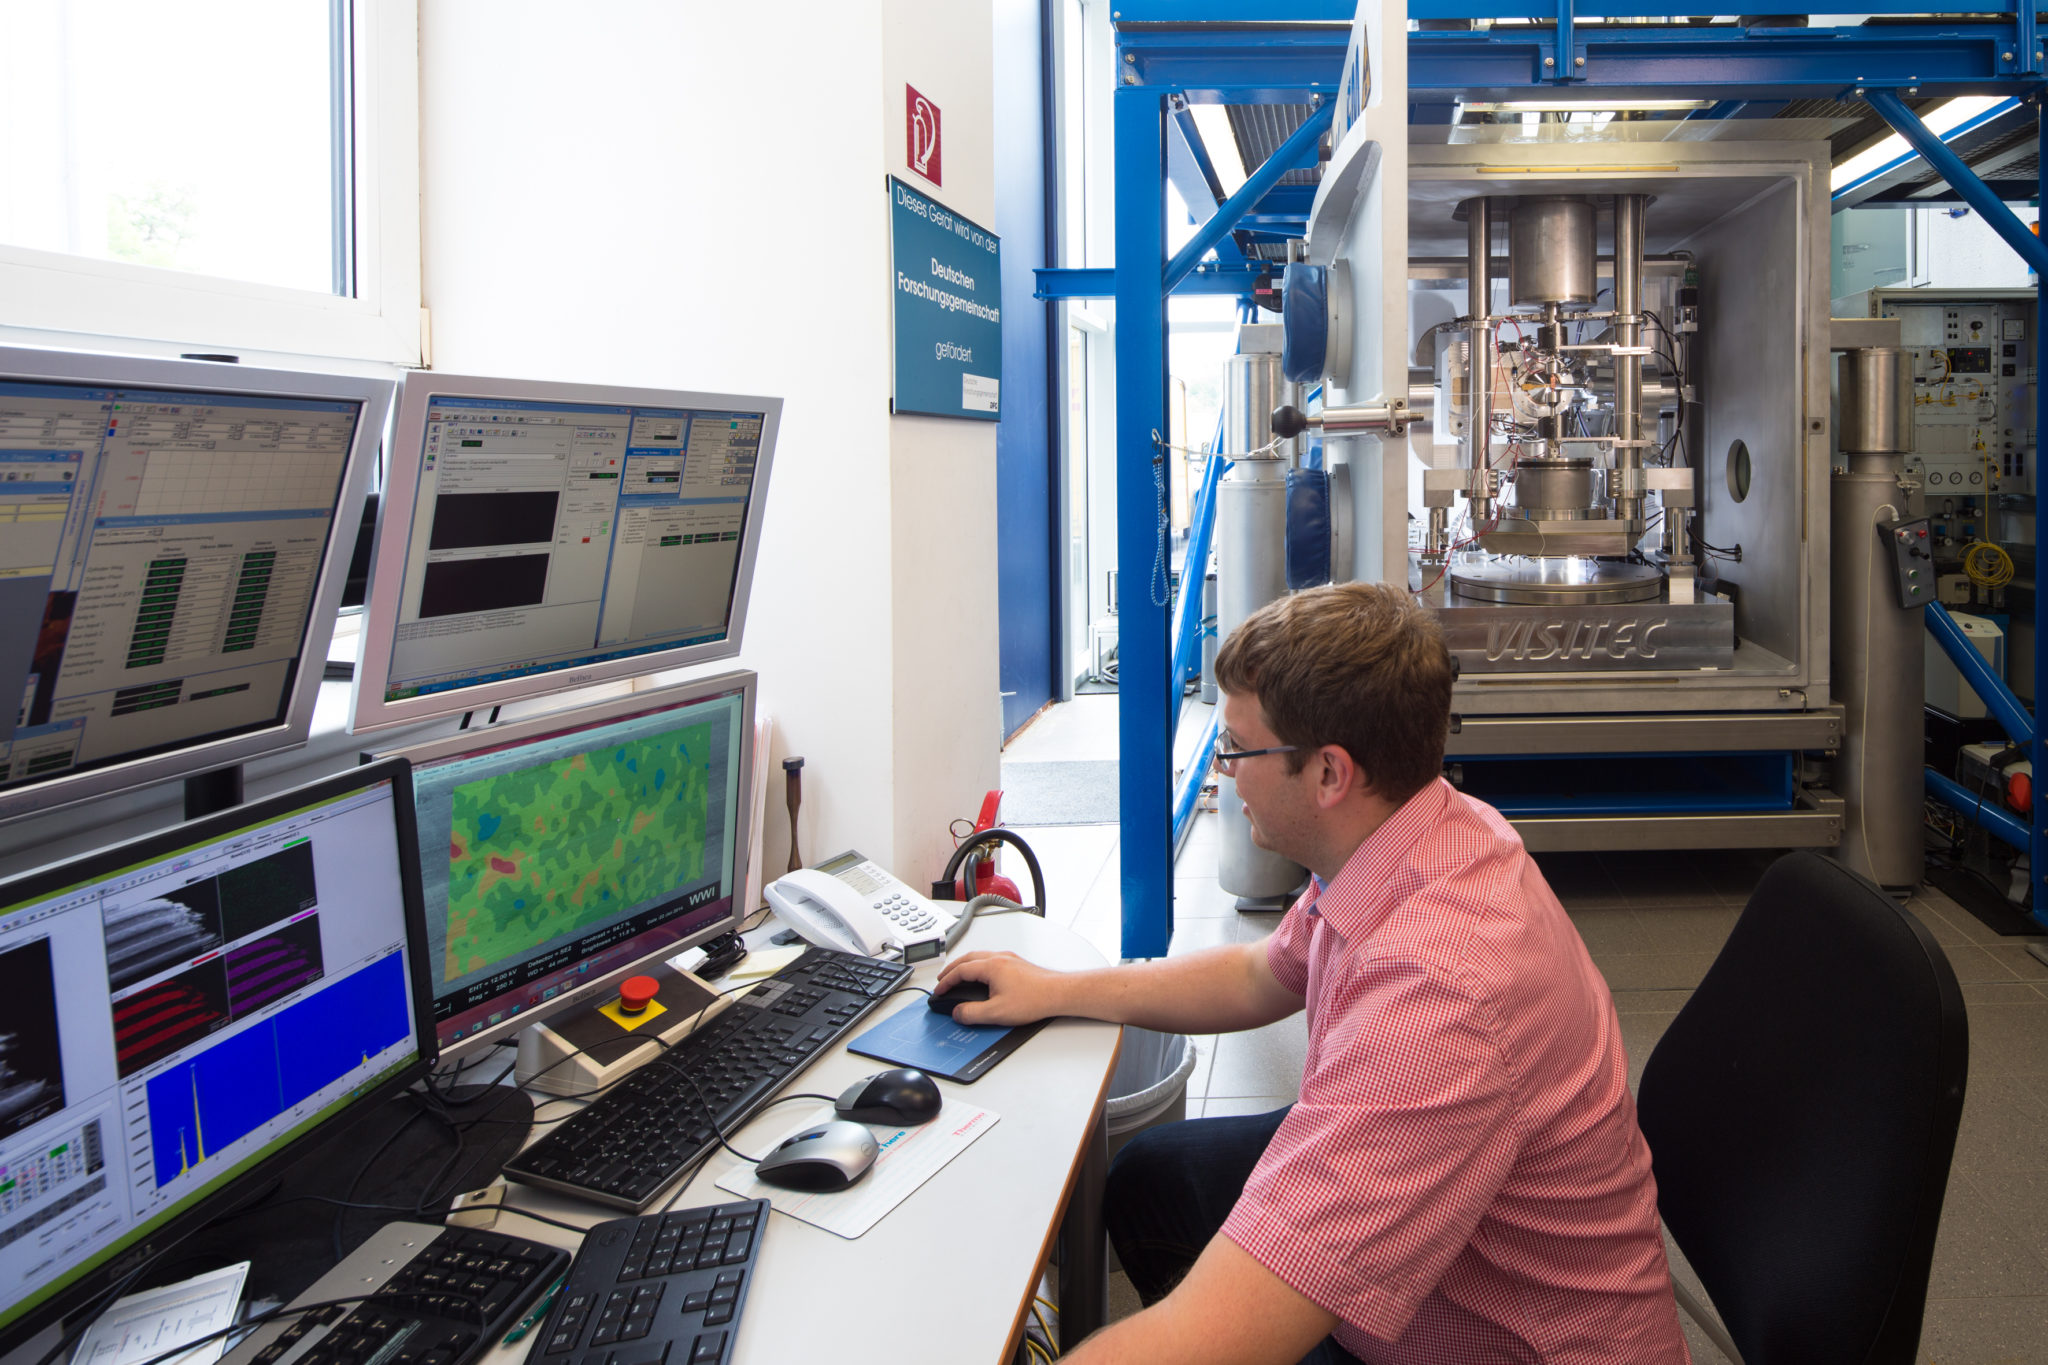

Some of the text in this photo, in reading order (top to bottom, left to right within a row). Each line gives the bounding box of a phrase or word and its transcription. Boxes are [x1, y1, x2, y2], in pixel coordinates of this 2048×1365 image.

[897, 185, 997, 254] Dieses Gerät wird von der
[931, 257, 974, 291] Deutschen
[898, 271, 1000, 323] Forschungsgemeinschaft
[689, 886, 716, 906] WWI
[581, 937, 612, 954] Brightness
[528, 953, 554, 969] Detector
[469, 983, 483, 994] EHT
[468, 993, 483, 1003] Mag
[882, 1131, 906, 1148] here
